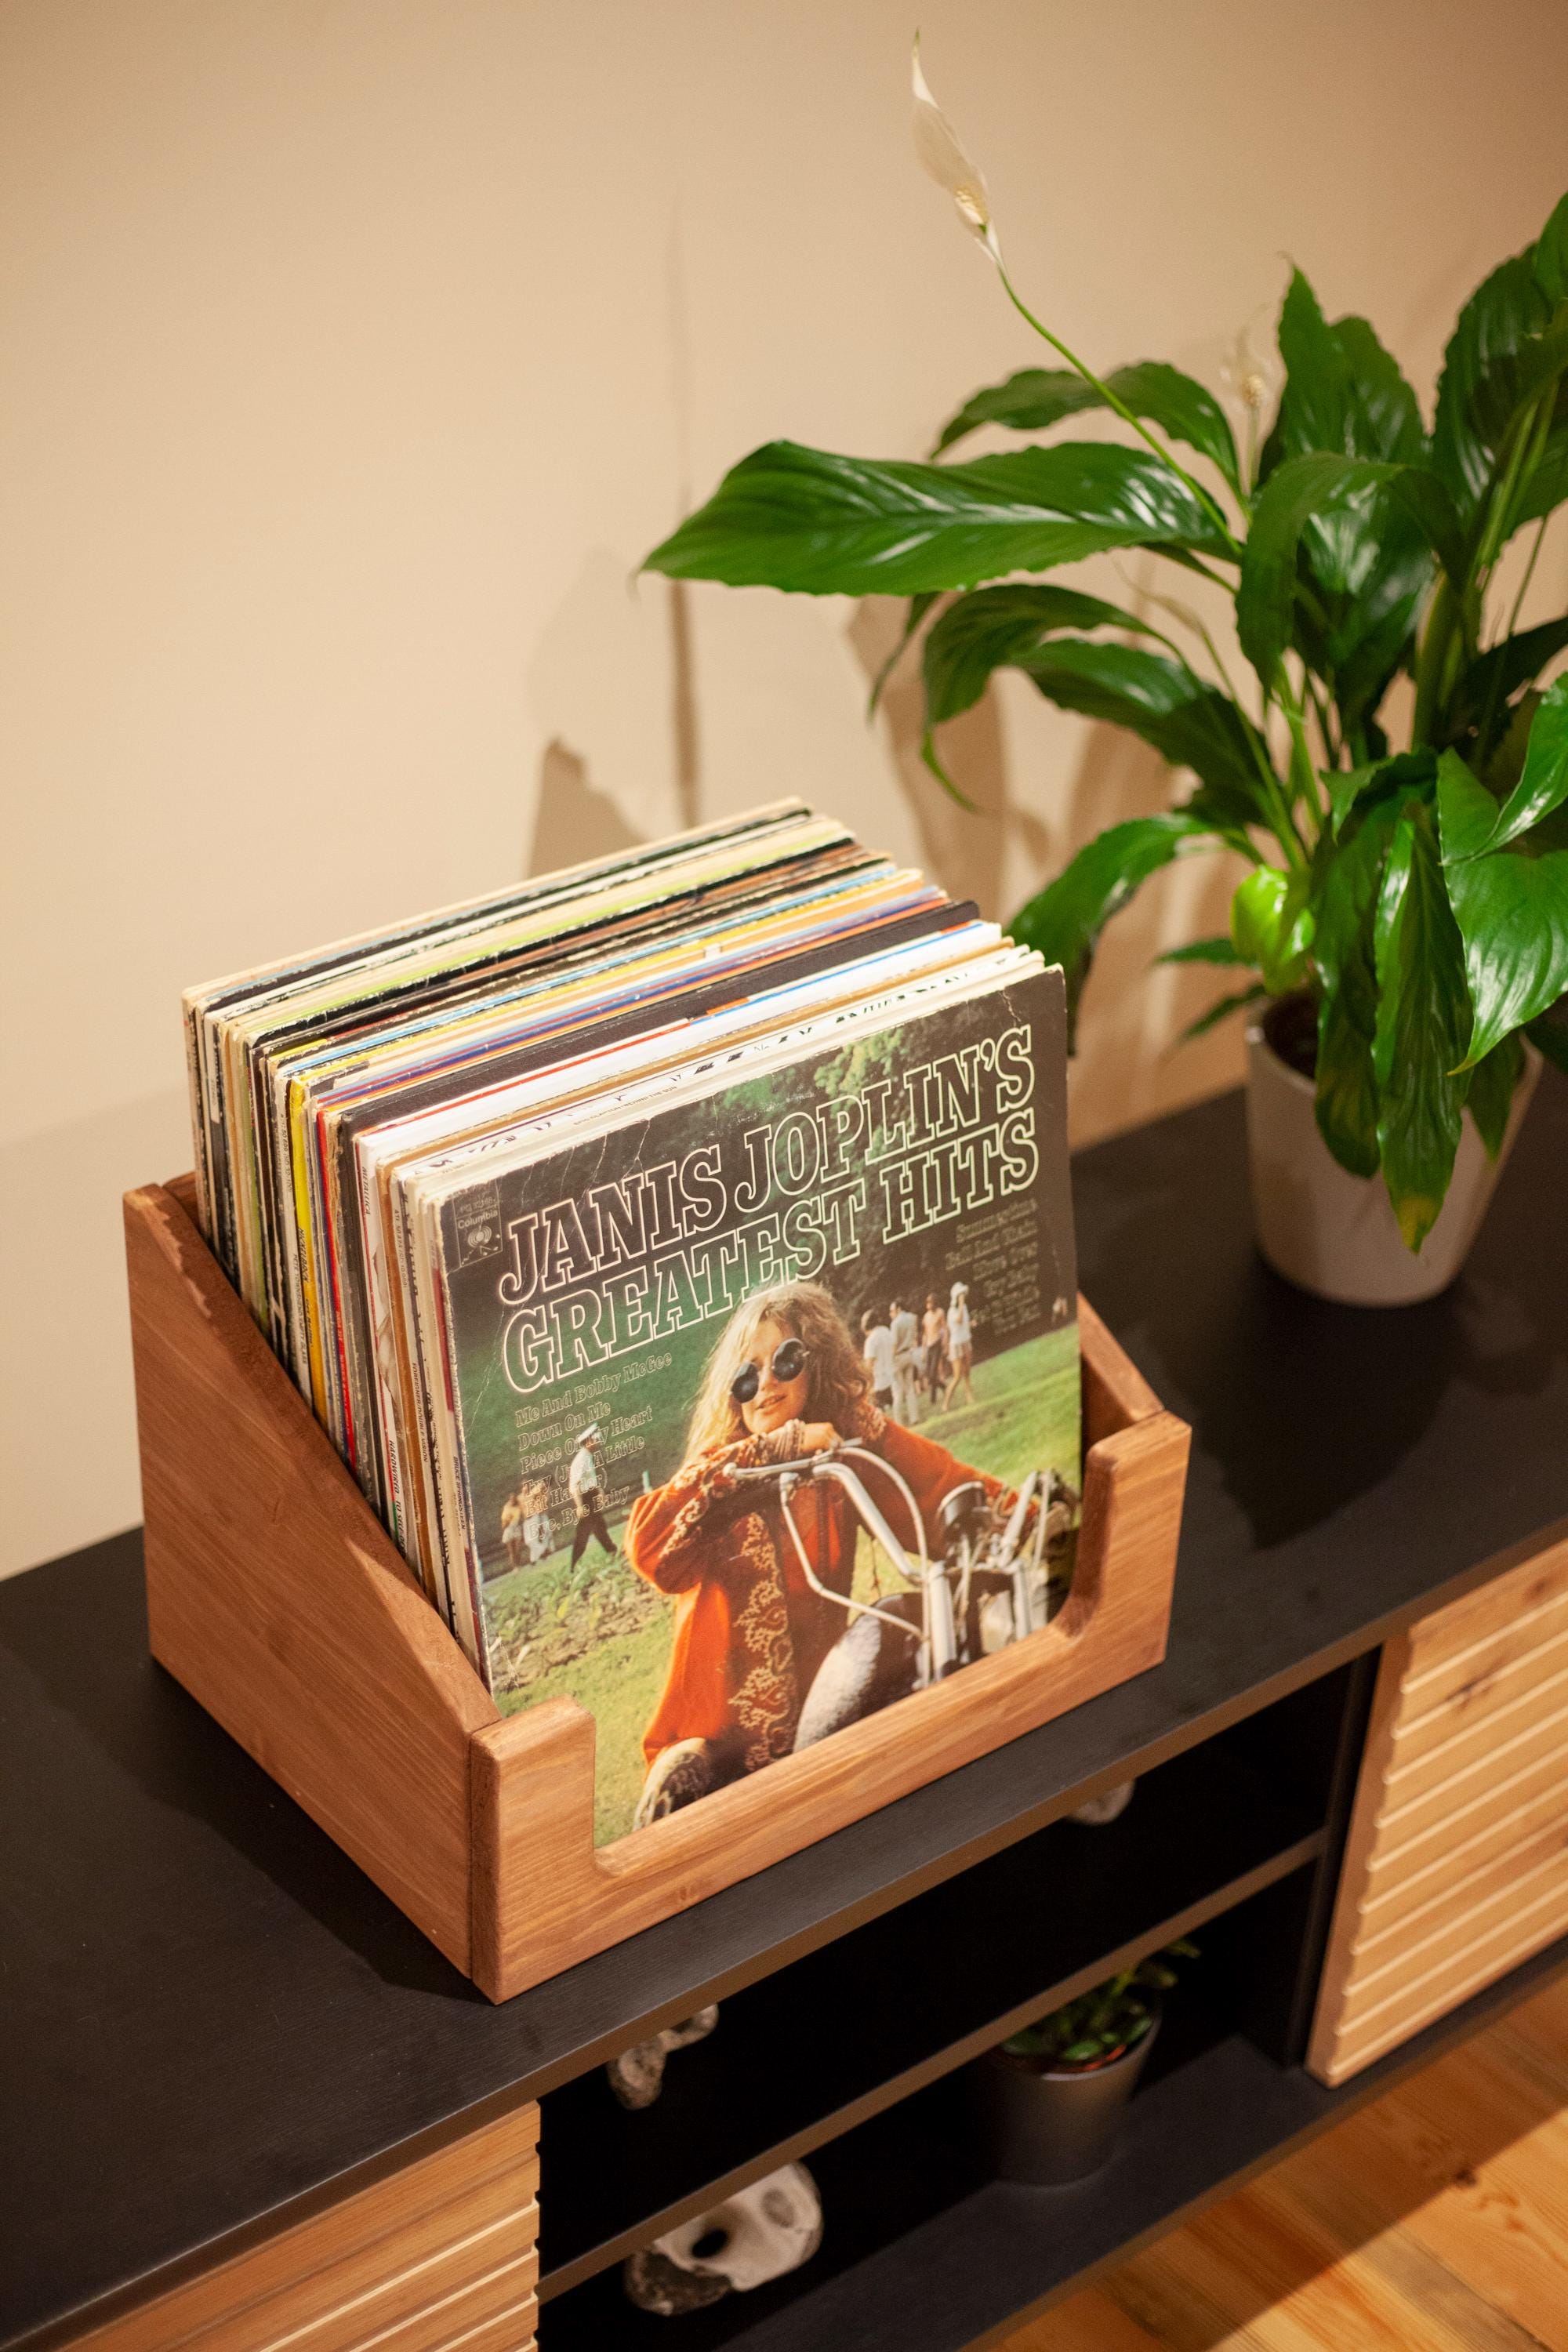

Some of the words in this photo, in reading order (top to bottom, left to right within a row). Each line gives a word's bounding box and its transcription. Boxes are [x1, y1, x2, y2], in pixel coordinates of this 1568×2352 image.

[498, 1144, 727, 1305] JANIS
[735, 1024, 1035, 1213] JOPLIN'S
[362, 1166, 371, 1215] METALLICA
[458, 1210, 499, 1229] Columbia
[298, 1228, 309, 1283] NICKELBACK
[503, 1178, 866, 1393] GREATEST
[880, 1107, 1039, 1244] HITS
[515, 1405, 540, 1428] Me
[542, 1390, 572, 1417] And
[575, 1371, 621, 1403] Bobby
[623, 1352, 672, 1383] McGee
[517, 1422, 563, 1450] Down
[564, 1413, 586, 1432] On
[587, 1402, 611, 1423] Me
[521, 1446, 562, 1474] Piece
[611, 1405, 653, 1436] Heart
[389, 1440, 401, 1494] HARDWIRED
[593, 1450, 604, 1468] A
[606, 1436, 645, 1464] Little
[525, 1494, 550, 1518] Bit
[592, 1486, 630, 1512] Baby
